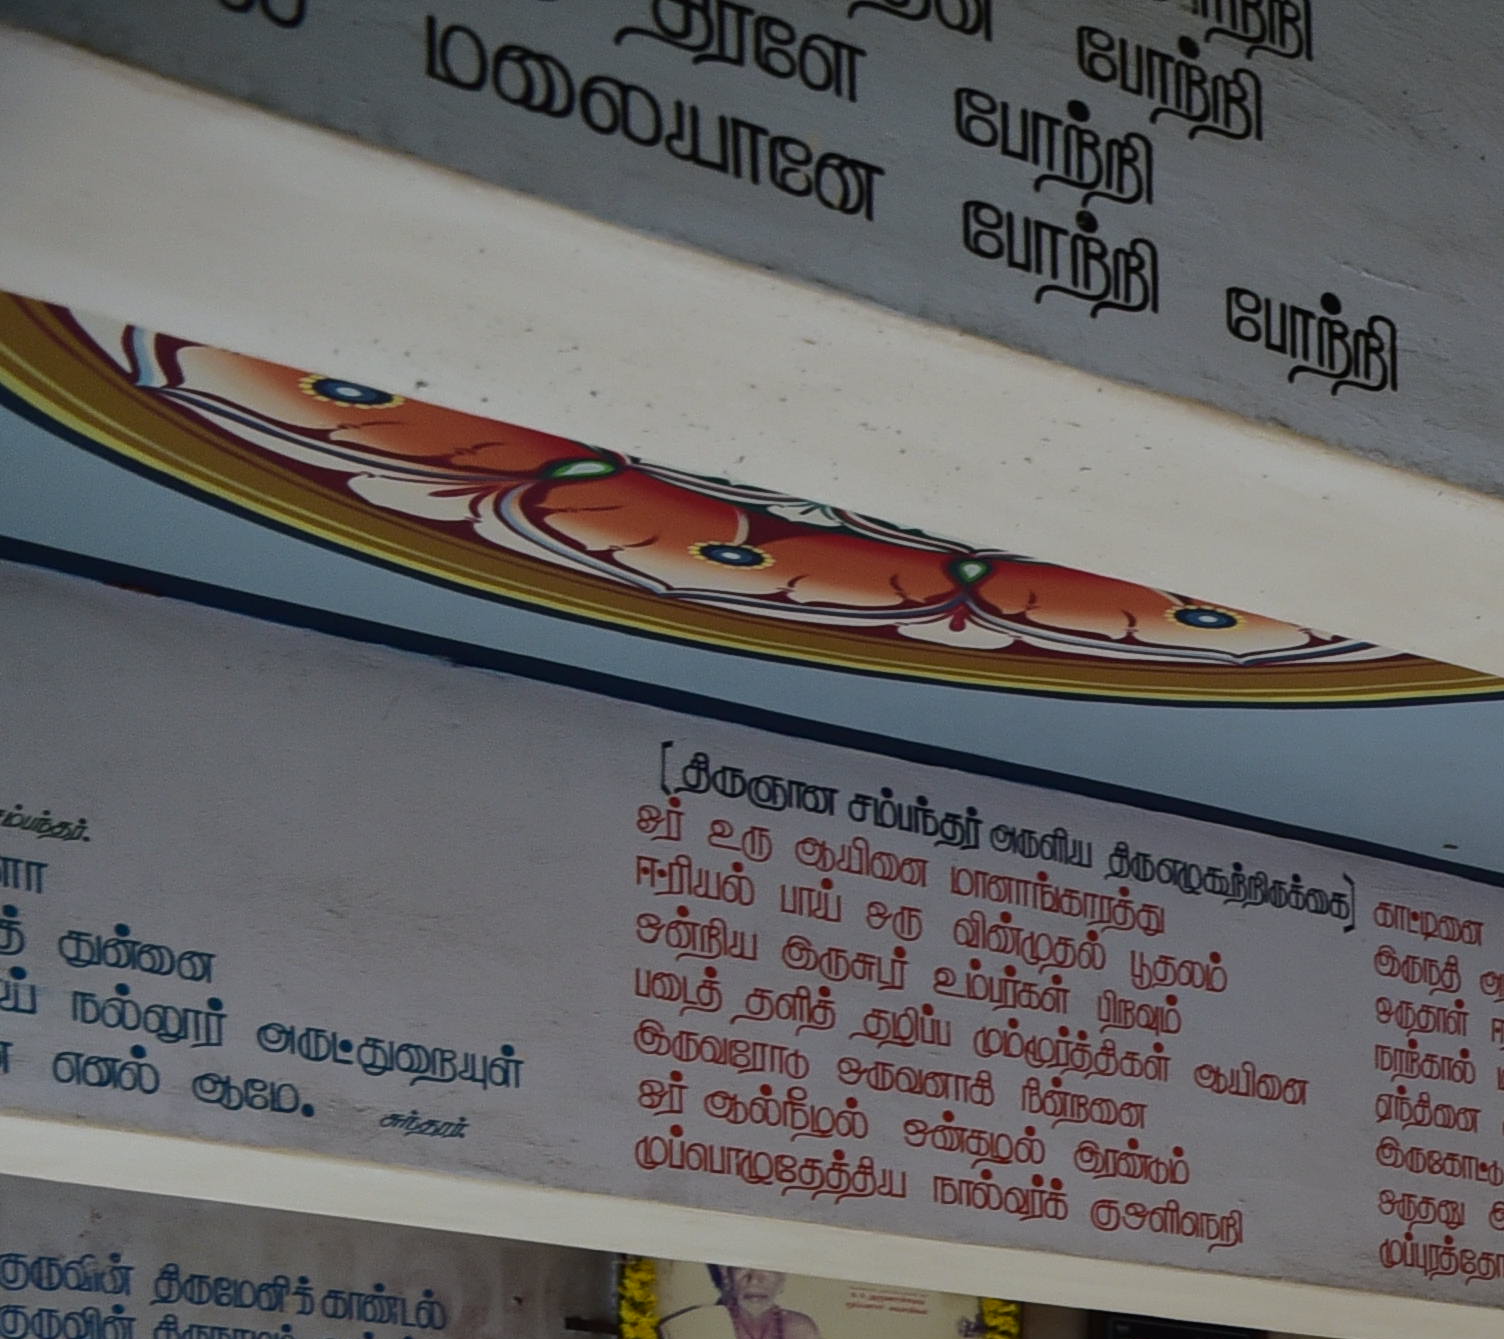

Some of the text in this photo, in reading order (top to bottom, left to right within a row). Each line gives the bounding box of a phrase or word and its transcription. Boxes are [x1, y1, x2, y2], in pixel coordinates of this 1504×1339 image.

[1077, 26, 1264, 142] போற்றி
[954, 87, 1155, 209] போற்றி
[425, 16, 1399, 397] மலையானே போற்றி போற்றி
[0, 803, 91, 844] ம்பந்தர்.
[707, 819, 774, 863] உரு
[794, 836, 930, 888] ஆயினை
[847, 786, 984, 851] சம்பந்தர்
[989, 824, 1093, 869] அருளிய
[57, 923, 218, 984] துன்னை
[636, 854, 1228, 993] ஈரியல் பாய் ஒரு விண்முதல் பூதலம்
[1372, 901, 1485, 947] காட்டினை
[70, 982, 228, 1049] நல்லூர்
[51, 1044, 161, 1095] எனல்
[185, 1072, 316, 1118] ஆமே.
[632, 1018, 1148, 1130] இருவரோடு ஒருவனாகி நின்றனை
[1374, 1038, 1476, 1085] நாற்கால்
[0, 1252, 447, 1330] குருவின் திருமேனிக் காண்டல்
